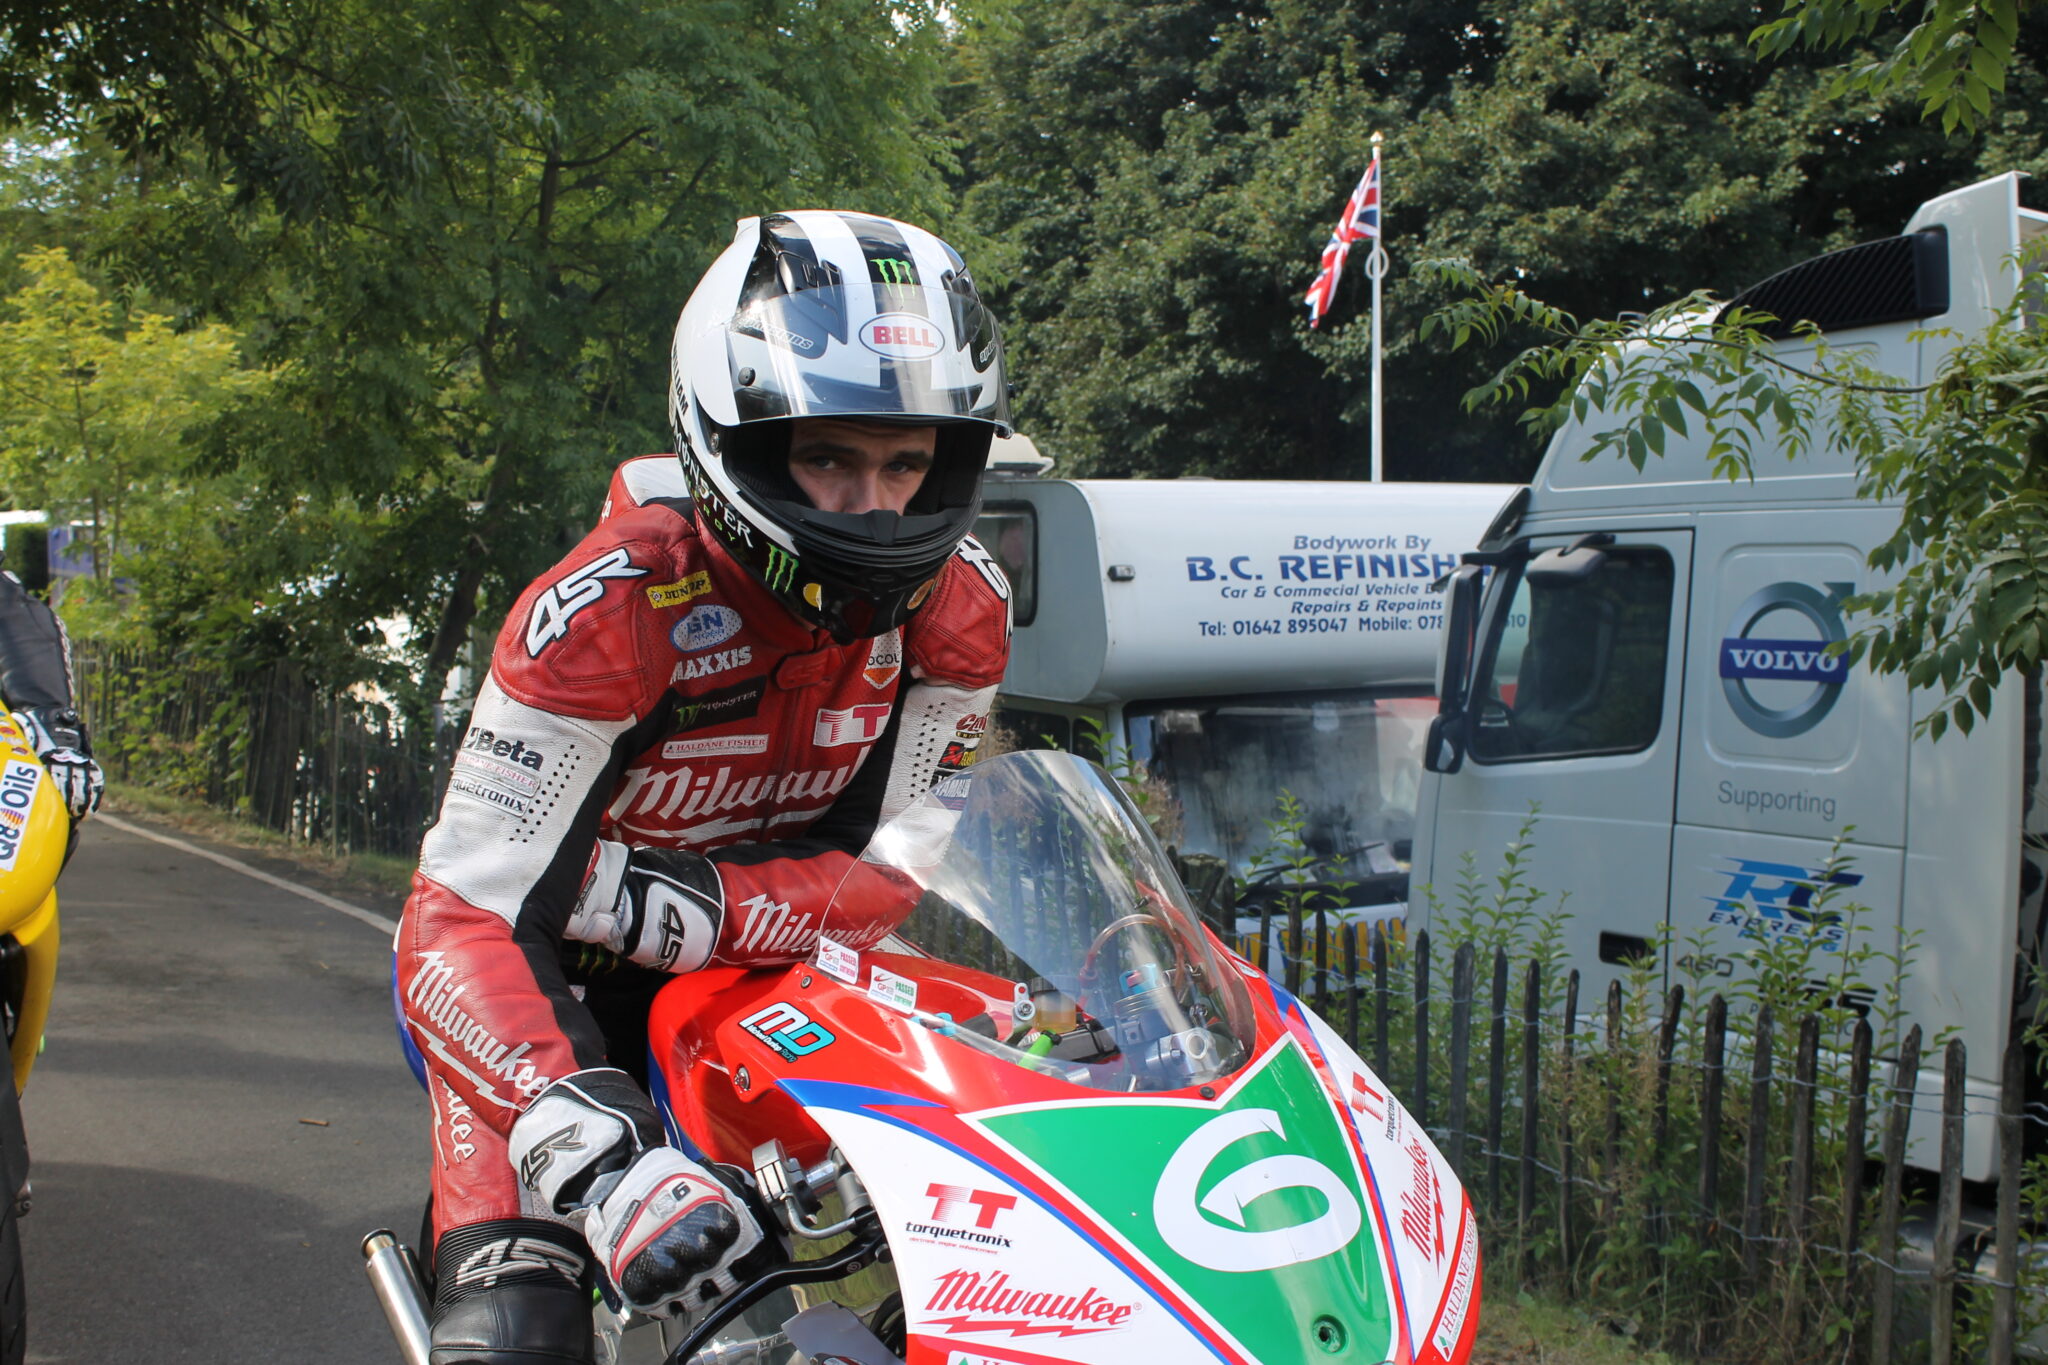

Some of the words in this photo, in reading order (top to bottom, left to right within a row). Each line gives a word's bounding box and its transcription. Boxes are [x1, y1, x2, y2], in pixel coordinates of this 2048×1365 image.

[873, 326, 936, 348] BELL
[1293, 535, 1397, 553] Bodywork
[1405, 535, 1431, 553] By
[1185, 556, 1264, 582] B.C.
[1279, 554, 1491, 583] REFINISH
[1220, 586, 1247, 599] Car
[1254, 585, 1266, 598] &
[1273, 584, 1360, 598] Commecial
[1365, 583, 1420, 596] Vehicle
[1290, 602, 1351, 615] Repairs
[1357, 600, 1369, 613] &
[1375, 599, 1443, 614] Repaints
[1198, 621, 1227, 636] Tel:
[1232, 620, 1281, 636] 01642
[1287, 618, 1347, 634] 895047
[1358, 615, 1412, 632] Mobile:
[669, 645, 753, 686] MAXXIS
[1728, 648, 1840, 673] VOLVO
[676, 740, 725, 751] HALDANE
[728, 739, 766, 747] FISHER
[1, 765, 39, 809] Oils
[496, 765, 537, 789] FISHER
[607, 745, 870, 822] Milwau
[1717, 780, 1837, 822] Supporting
[406, 949, 550, 1098] Milwaukee
[1152, 1107, 1362, 1273] 6
[905, 1221, 1012, 1248] torquetronix
[920, 1267, 1133, 1325] Milwaukee
[1441, 1258, 1470, 1335] HALDANE
